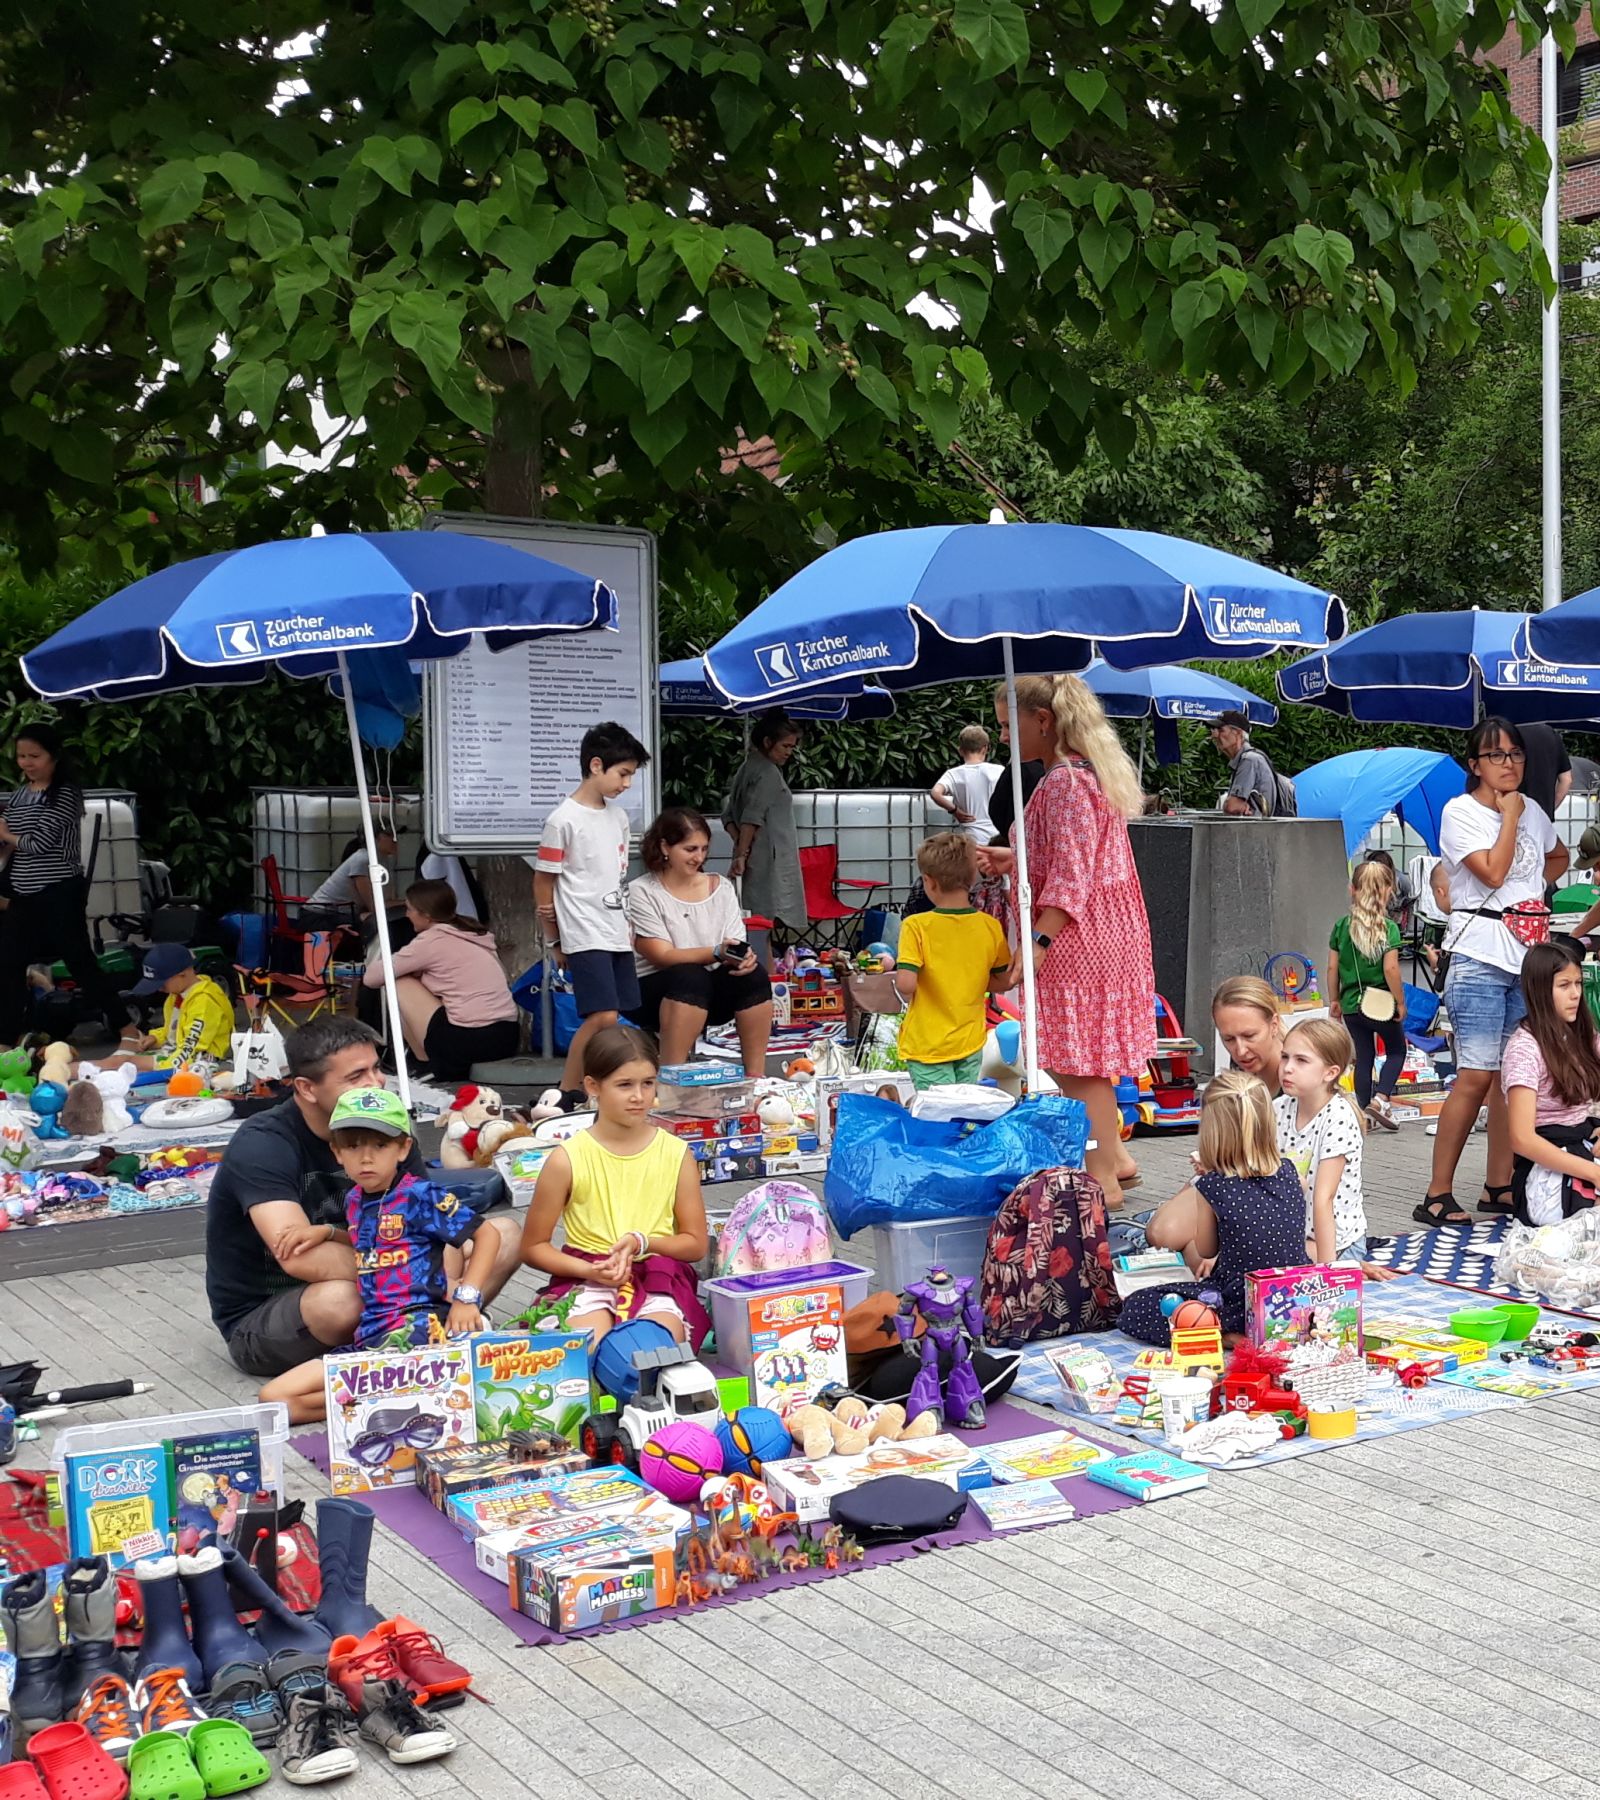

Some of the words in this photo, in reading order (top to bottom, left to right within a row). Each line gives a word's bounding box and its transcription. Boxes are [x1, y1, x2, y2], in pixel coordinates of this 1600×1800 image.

[1230, 602, 1266, 619] Zürcher
[264, 615, 325, 635] Zürcher
[267, 623, 375, 648] Kantonalbank
[1230, 618, 1302, 635] Kantonalbank
[795, 635, 849, 657] Zürcher
[800, 642, 891, 673] Kantonalbank
[1523, 672, 1590, 686] Kantonalbank
[694, 1072, 722, 1082] MEMO
[1293, 1274, 1329, 1298] XXL
[1309, 1285, 1346, 1306] PUZZLE
[1271, 1291, 1285, 1304] 45
[477, 1340, 529, 1367] Harry
[493, 1349, 565, 1381] Hopper
[193, 1453, 208, 1464] Die
[78, 1458, 159, 1493] DORK
[90, 1481, 152, 1499] diaries
[588, 1571, 646, 1599] MATCH
[590, 1587, 645, 1611] MADNESS
